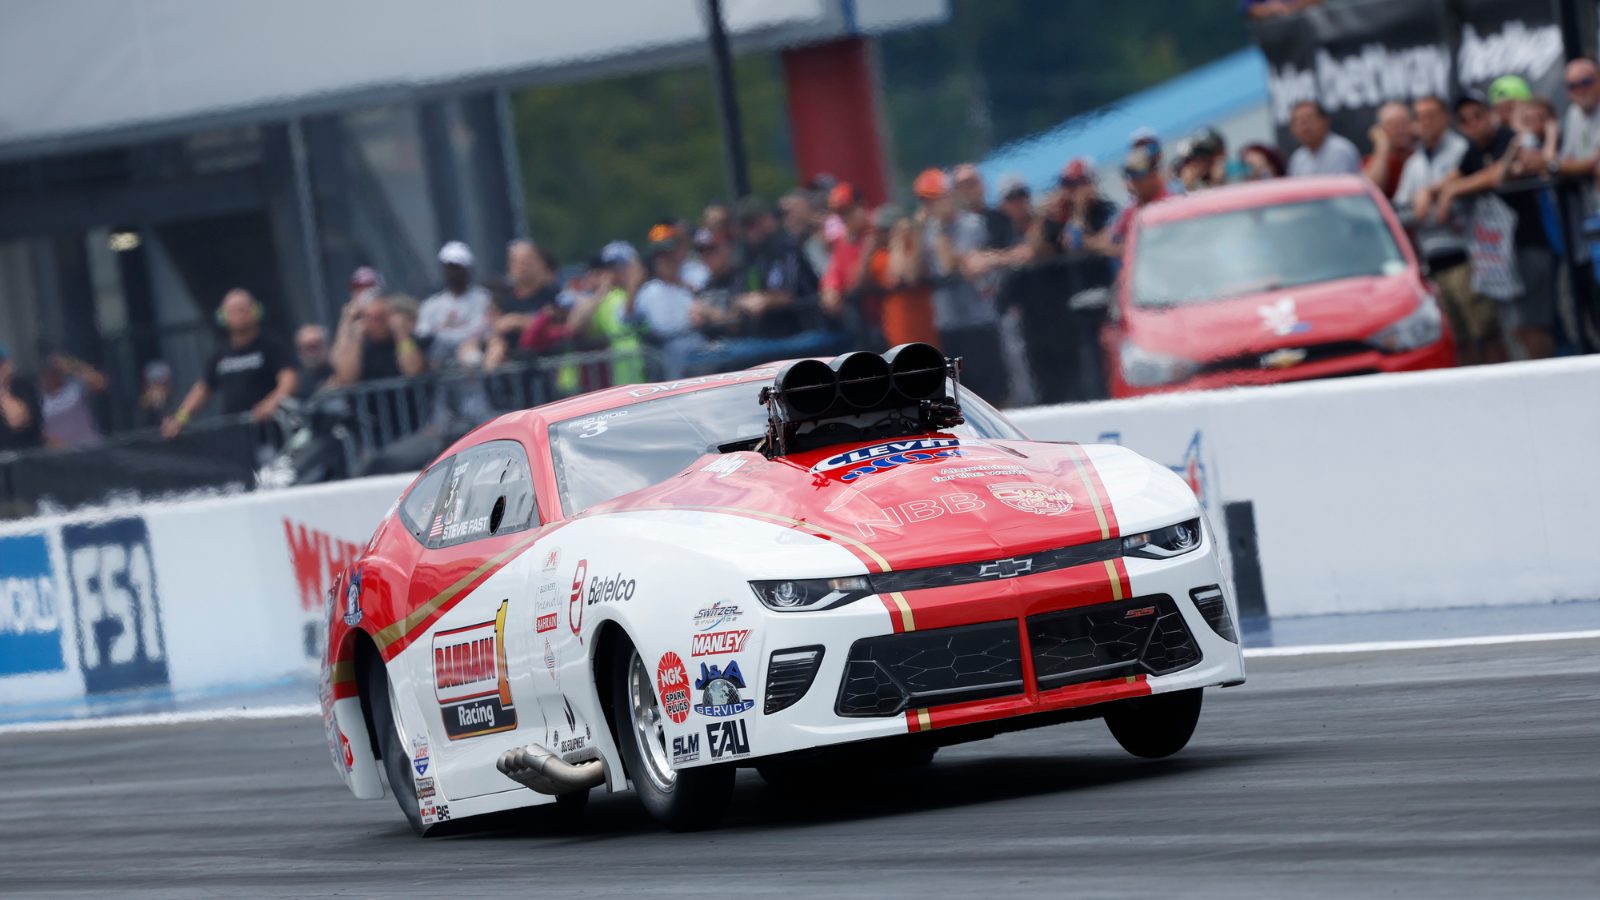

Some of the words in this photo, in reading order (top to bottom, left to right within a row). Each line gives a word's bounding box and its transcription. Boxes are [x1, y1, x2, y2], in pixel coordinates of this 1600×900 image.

[579, 420, 608, 438] 3
[854, 492, 986, 538] NBB
[442, 520, 469, 540] STEVIE
[468, 515, 489, 534] FAST
[588, 572, 636, 605] Batelco
[537, 615, 557, 632] BAHRAIN
[694, 605, 743, 619] SWITZER
[692, 631, 748, 656] MANLEY
[435, 636, 496, 690] BAHRAIN
[660, 666, 684, 688] NGK
[665, 690, 686, 703] SPARK
[667, 701, 688, 714] PLUGS
[458, 702, 496, 727] Racing
[696, 702, 752, 717] SERVICE
[673, 732, 699, 757] SLM
